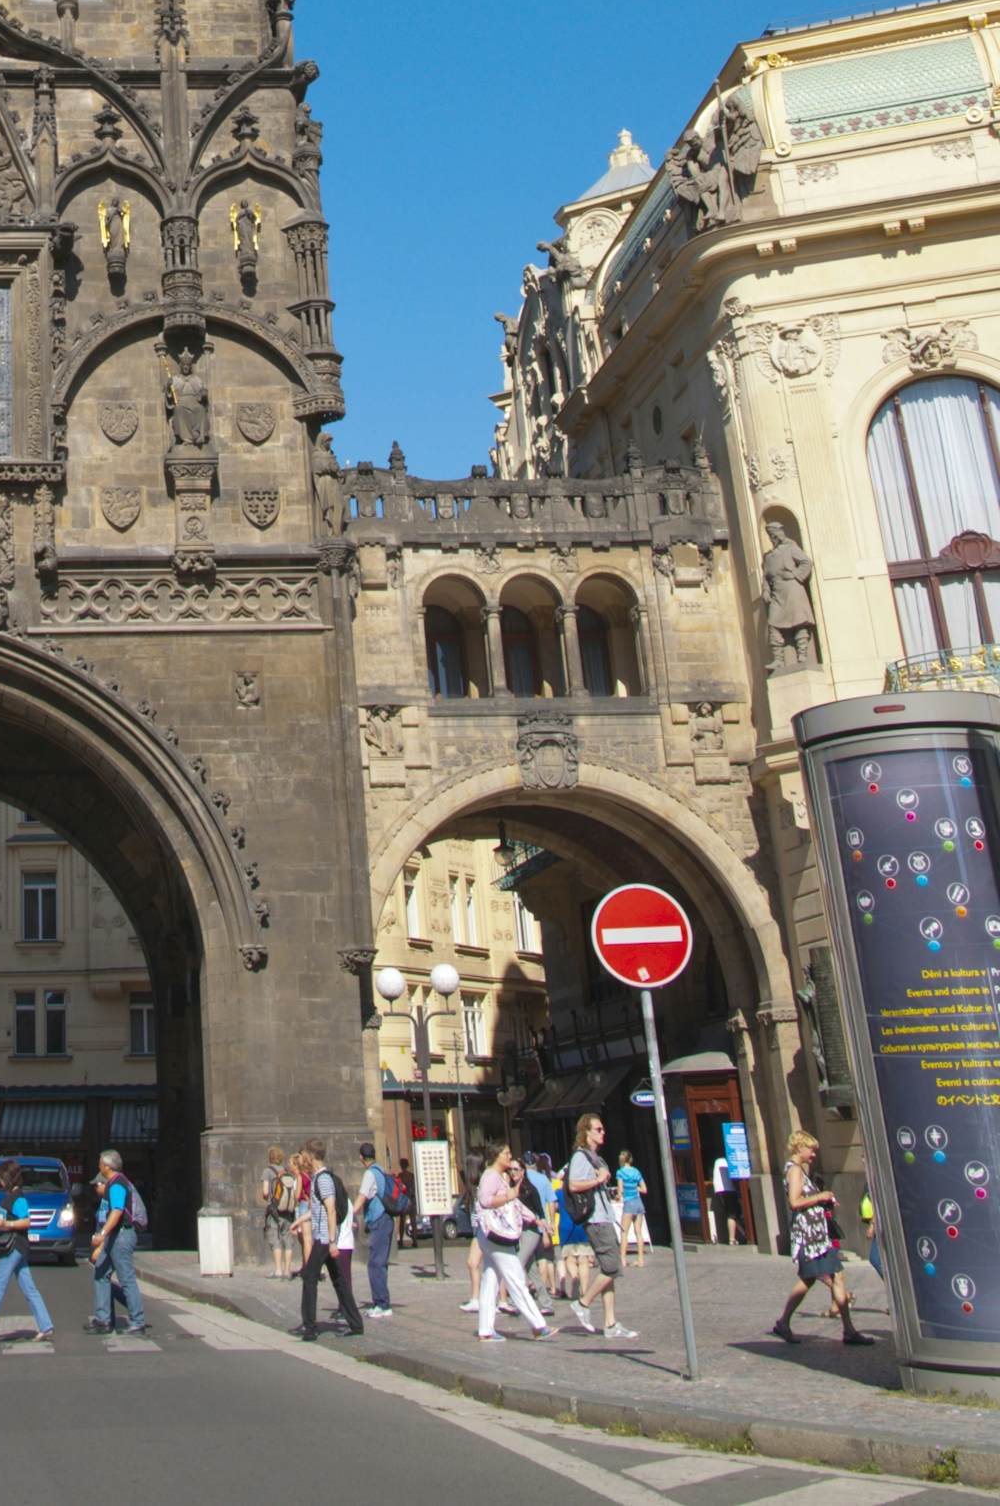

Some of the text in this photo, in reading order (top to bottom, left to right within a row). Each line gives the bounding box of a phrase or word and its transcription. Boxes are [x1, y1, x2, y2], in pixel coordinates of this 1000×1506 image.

[950, 968, 980, 977] kultura
[906, 988, 932, 997] Events
[934, 987, 949, 996] and
[951, 986, 980, 995] culture
[982, 986, 990, 994] in
[940, 1004, 955, 1013] und
[957, 1004, 983, 1013] Kultur
[984, 1004, 992, 1013] in
[941, 1024, 949, 1032] et
[951, 1023, 959, 1031] la
[961, 1022, 990, 1031] culture
[921, 1059, 952, 1069] Eventos
[936, 1078, 961, 1087] Eventi
